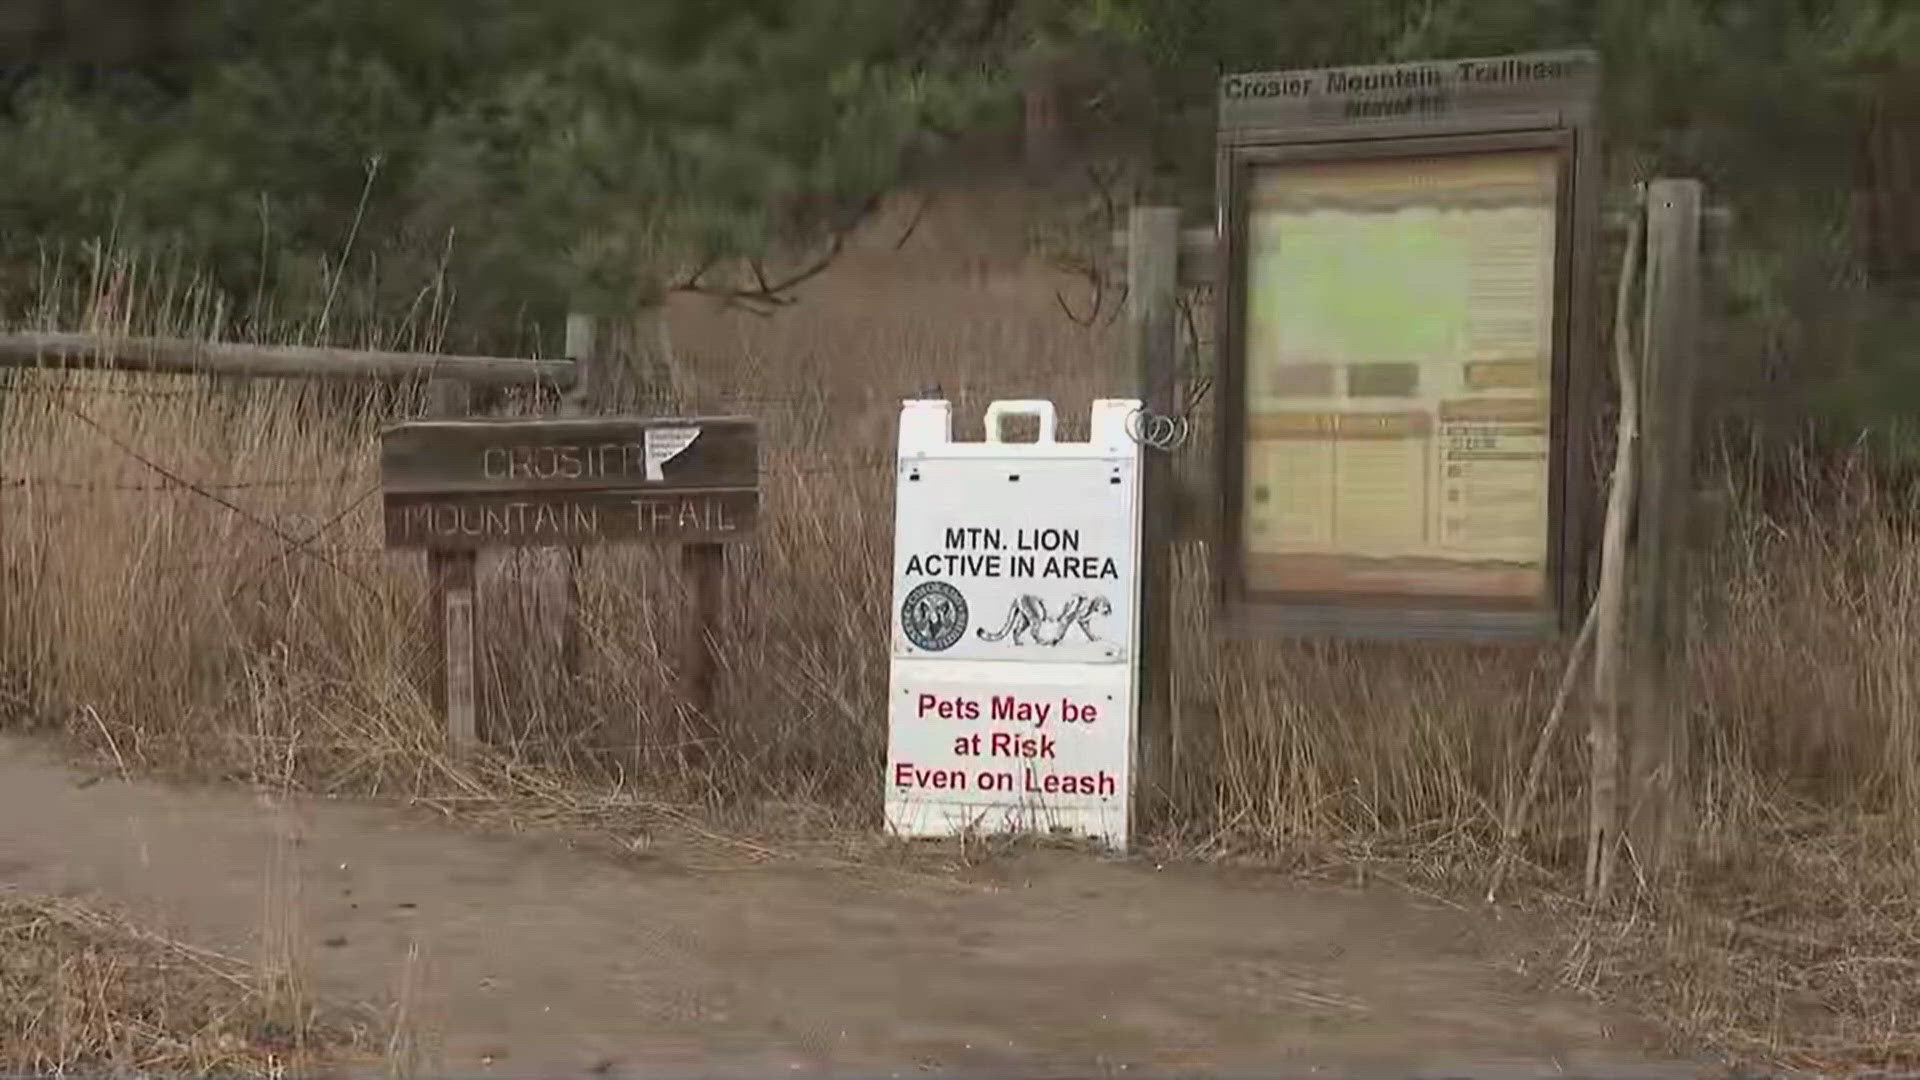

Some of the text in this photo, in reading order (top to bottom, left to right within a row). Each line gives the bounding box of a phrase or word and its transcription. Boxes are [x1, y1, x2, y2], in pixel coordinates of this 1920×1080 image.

[1224, 77, 1312, 99] Crosier
[1326, 66, 1440, 94] Mountain
[404, 497, 736, 537] MOUNTAIN TRAIL
[945, 527, 1080, 551] MTN. LION
[905, 554, 1118, 579] ACTIVE IN AREA
[918, 693, 1098, 728] Pets May be
[954, 733, 1056, 759] at Risk
[895, 763, 1116, 796] Even on Leash
